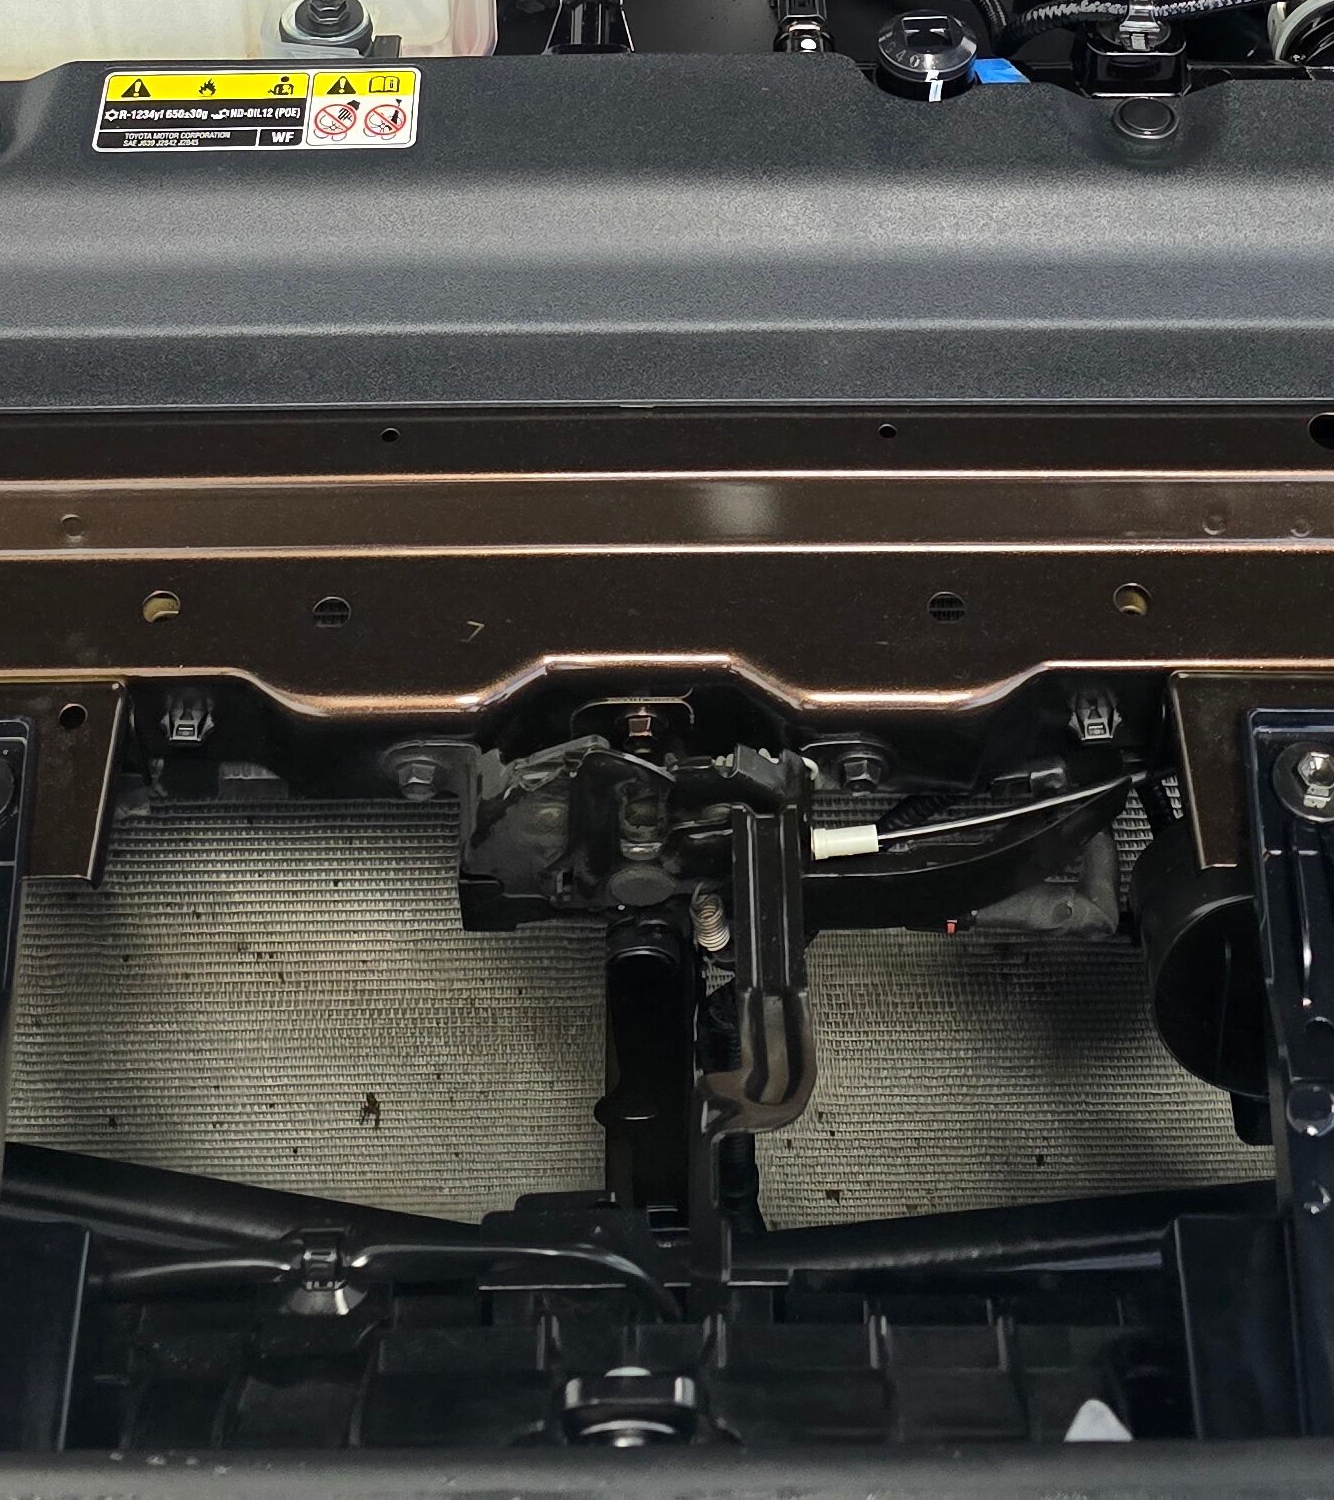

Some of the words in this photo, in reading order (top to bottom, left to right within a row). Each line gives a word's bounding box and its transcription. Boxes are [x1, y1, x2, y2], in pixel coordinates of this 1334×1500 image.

[119, 108, 165, 122] R-1234yf
[274, 106, 301, 120] (POE)
[124, 133, 153, 141] TOYOTA
[153, 132, 179, 141] MOTOR
[180, 131, 231, 140] CORPORATION
[271, 132, 295, 144] WF
[123, 139, 137, 147] SAE
